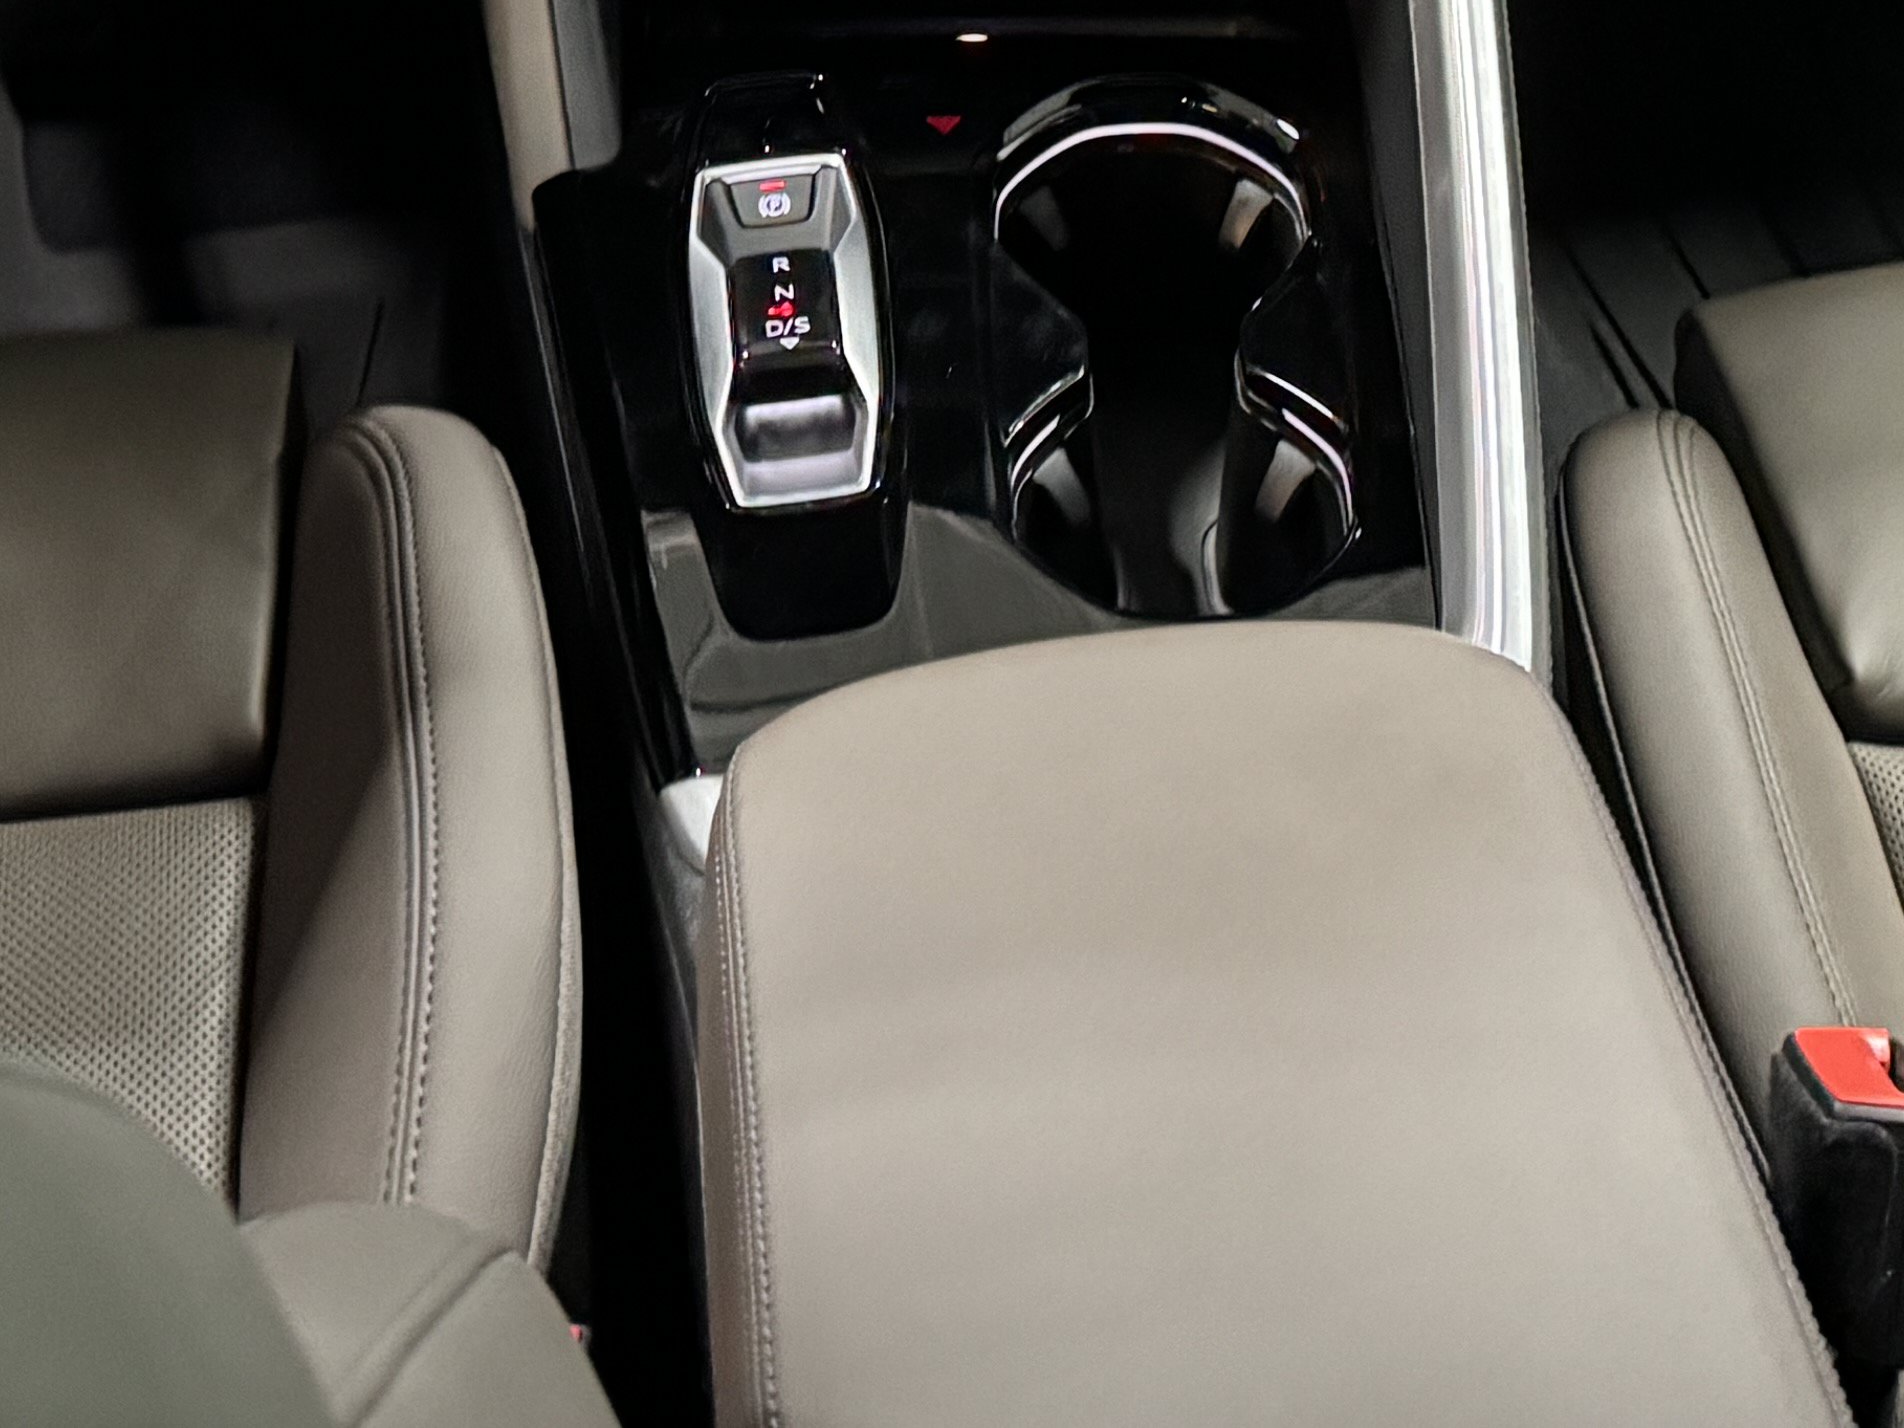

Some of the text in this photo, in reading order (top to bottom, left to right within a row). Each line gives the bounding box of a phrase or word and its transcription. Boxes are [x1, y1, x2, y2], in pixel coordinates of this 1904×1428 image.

[772, 256, 791, 274] R
[774, 283, 795, 302] N
[764, 315, 812, 339] D/S
